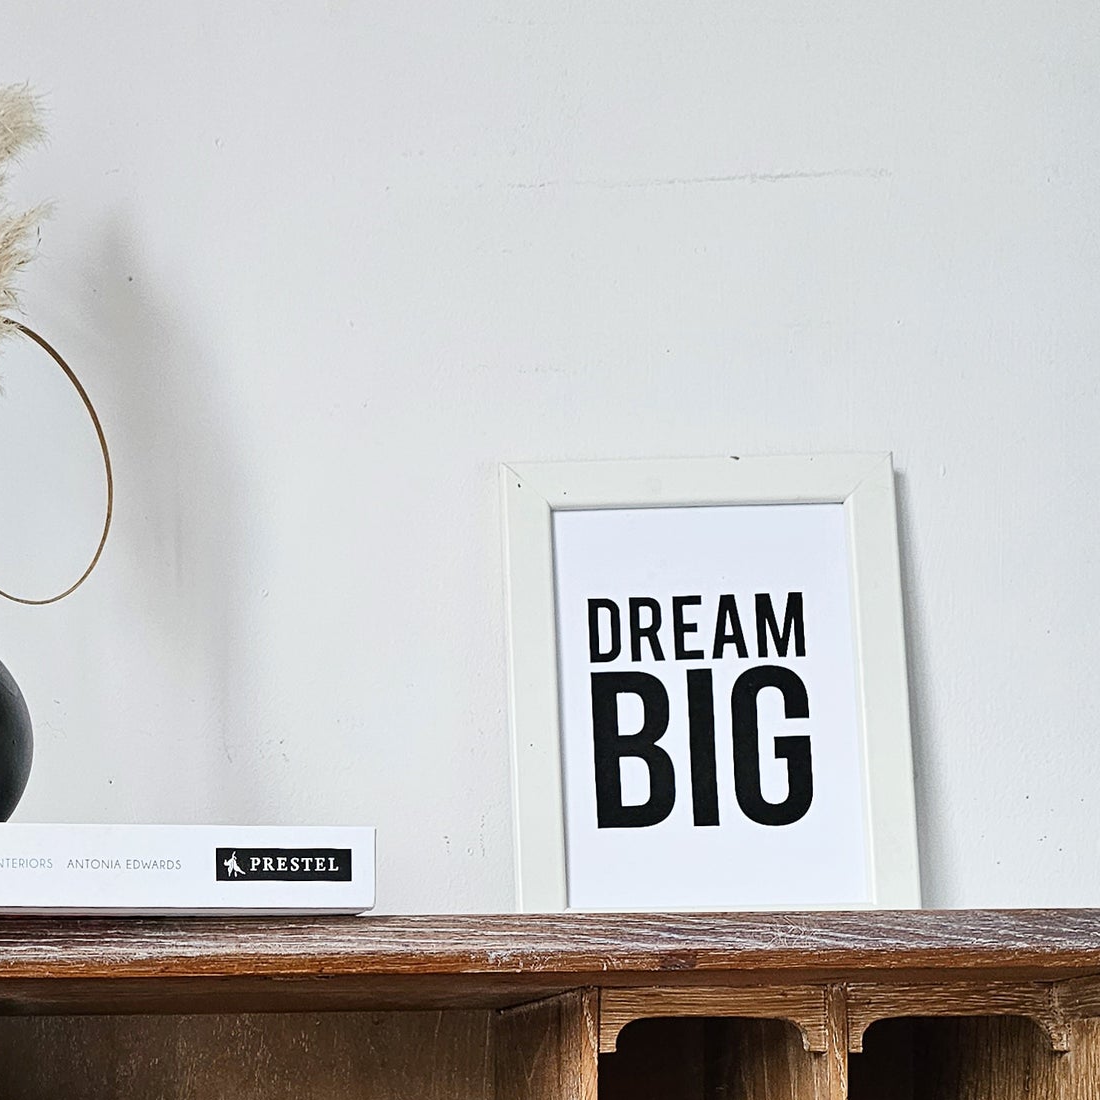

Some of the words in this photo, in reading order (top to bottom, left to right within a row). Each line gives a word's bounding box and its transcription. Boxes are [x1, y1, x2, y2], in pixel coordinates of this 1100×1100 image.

[587, 591, 806, 663] DREAM
[590, 664, 814, 829] BIG
[66, 858, 122, 870] ANTONIA
[125, 858, 182, 870] EDWARDS
[249, 856, 340, 873] PRESTEL
